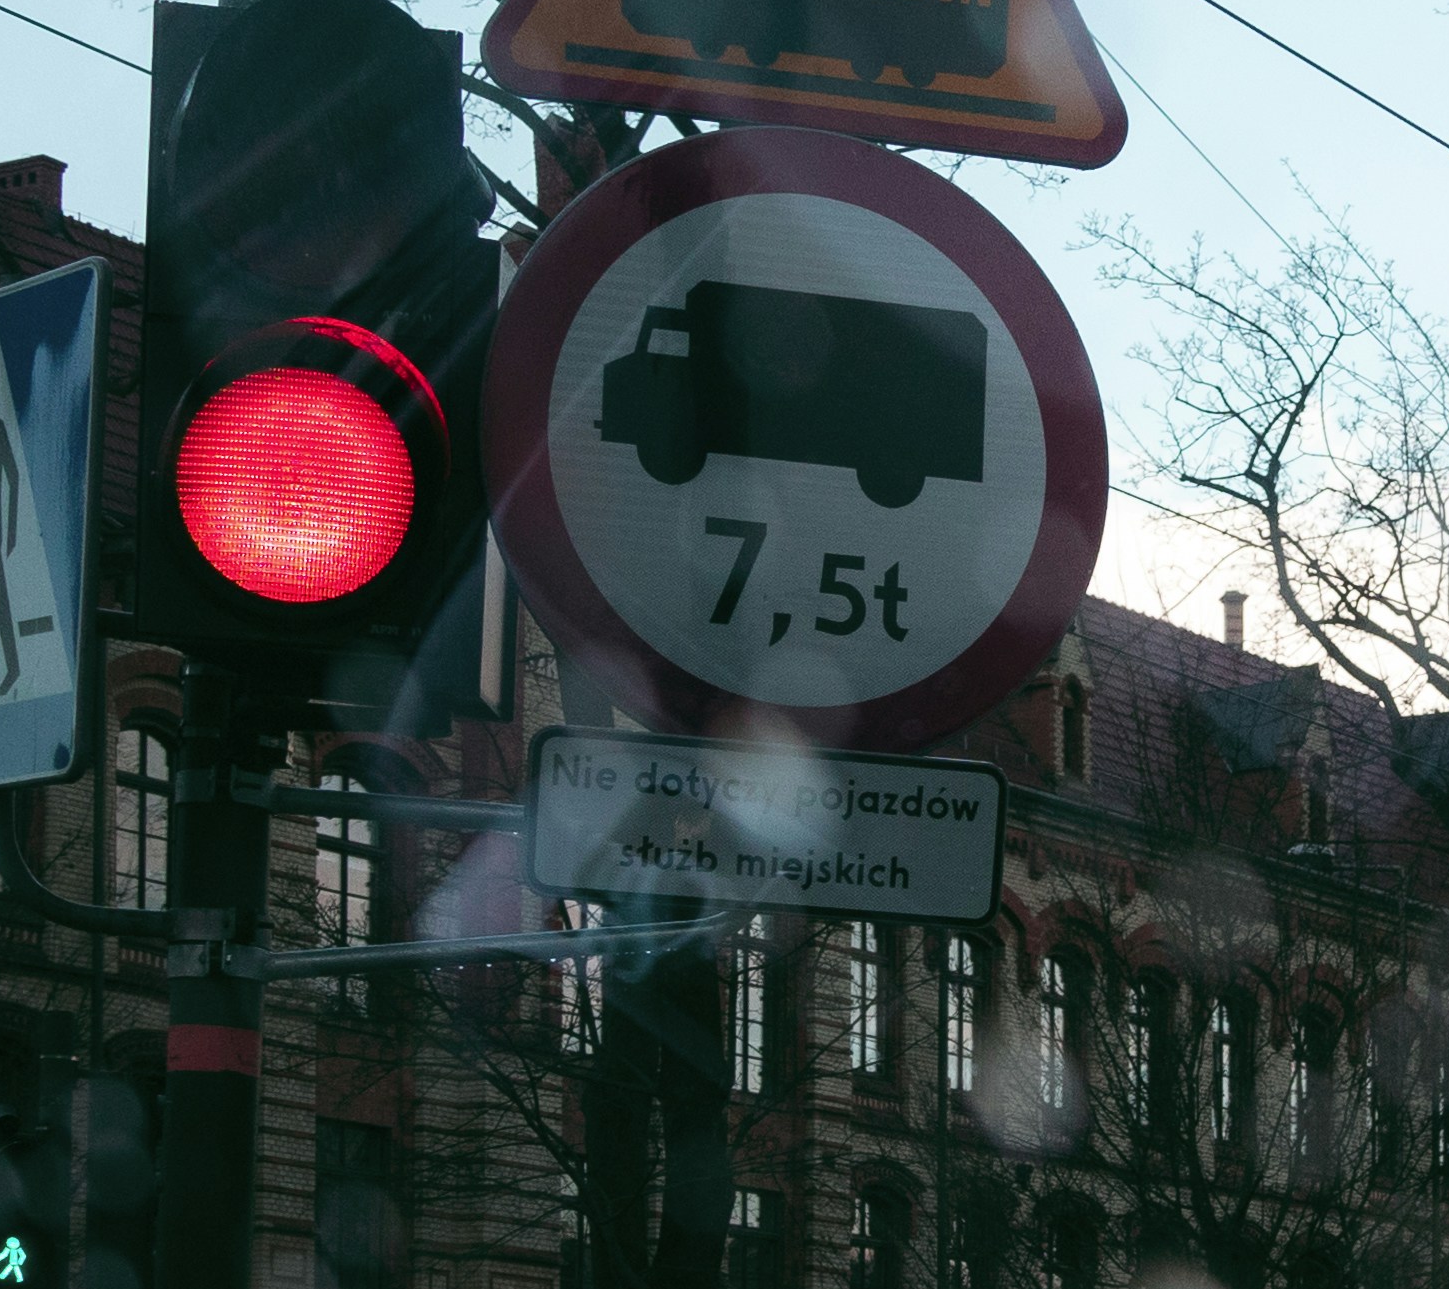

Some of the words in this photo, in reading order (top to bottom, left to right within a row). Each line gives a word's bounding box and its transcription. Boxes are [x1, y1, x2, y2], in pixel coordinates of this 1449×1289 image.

[704, 515, 910, 647] 7,5t
[551, 752, 618, 791] Nie
[635, 761, 780, 814] dotyczy
[794, 780, 980, 823] pojazdów
[619, 836, 718, 874] służb
[735, 847, 910, 891] miejskich
